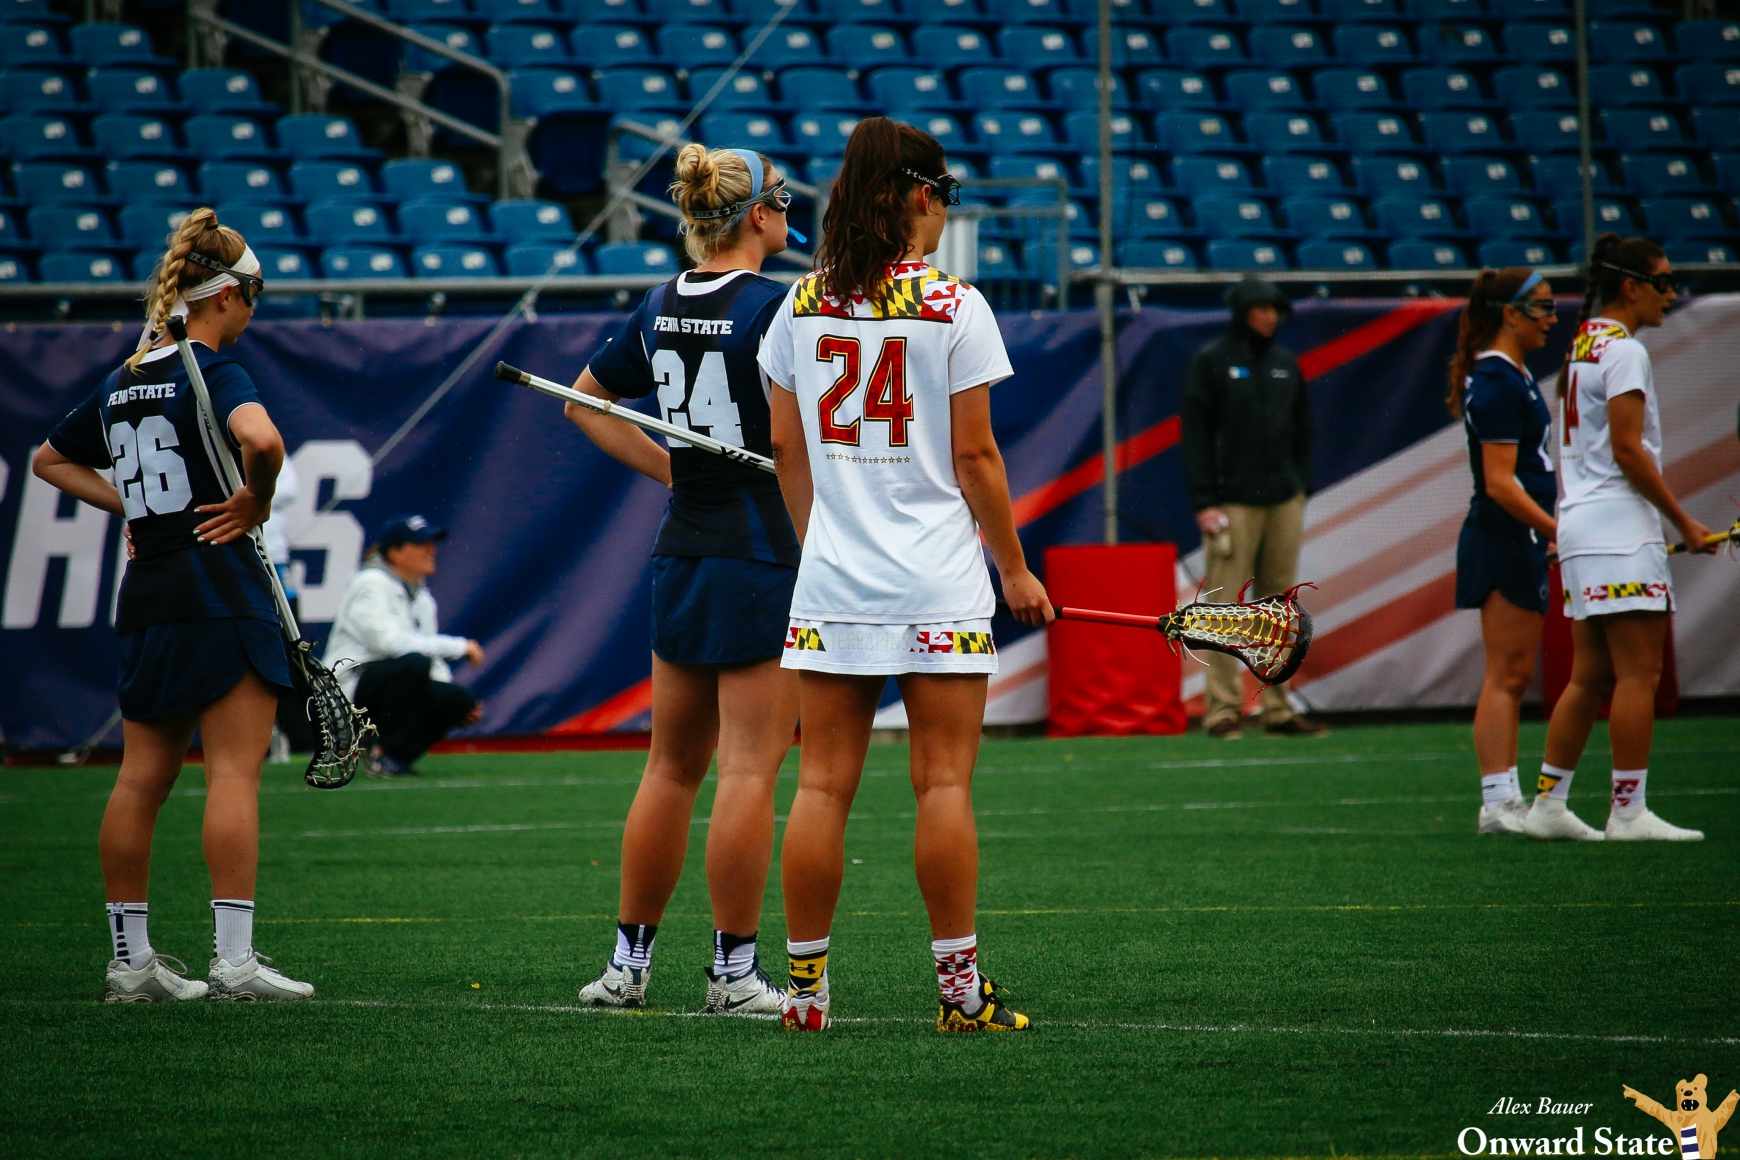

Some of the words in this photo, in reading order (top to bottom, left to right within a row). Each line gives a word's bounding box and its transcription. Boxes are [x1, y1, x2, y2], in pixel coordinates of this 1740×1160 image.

[918, 174, 940, 188] UNDE
[653, 315, 680, 333] PENN
[680, 318, 734, 335] STATE
[128, 382, 176, 401] STATE
[651, 349, 745, 448] 24
[816, 333, 914, 447] 24
[109, 414, 193, 521] 26
[830, 631, 910, 652] TERRAPINS
